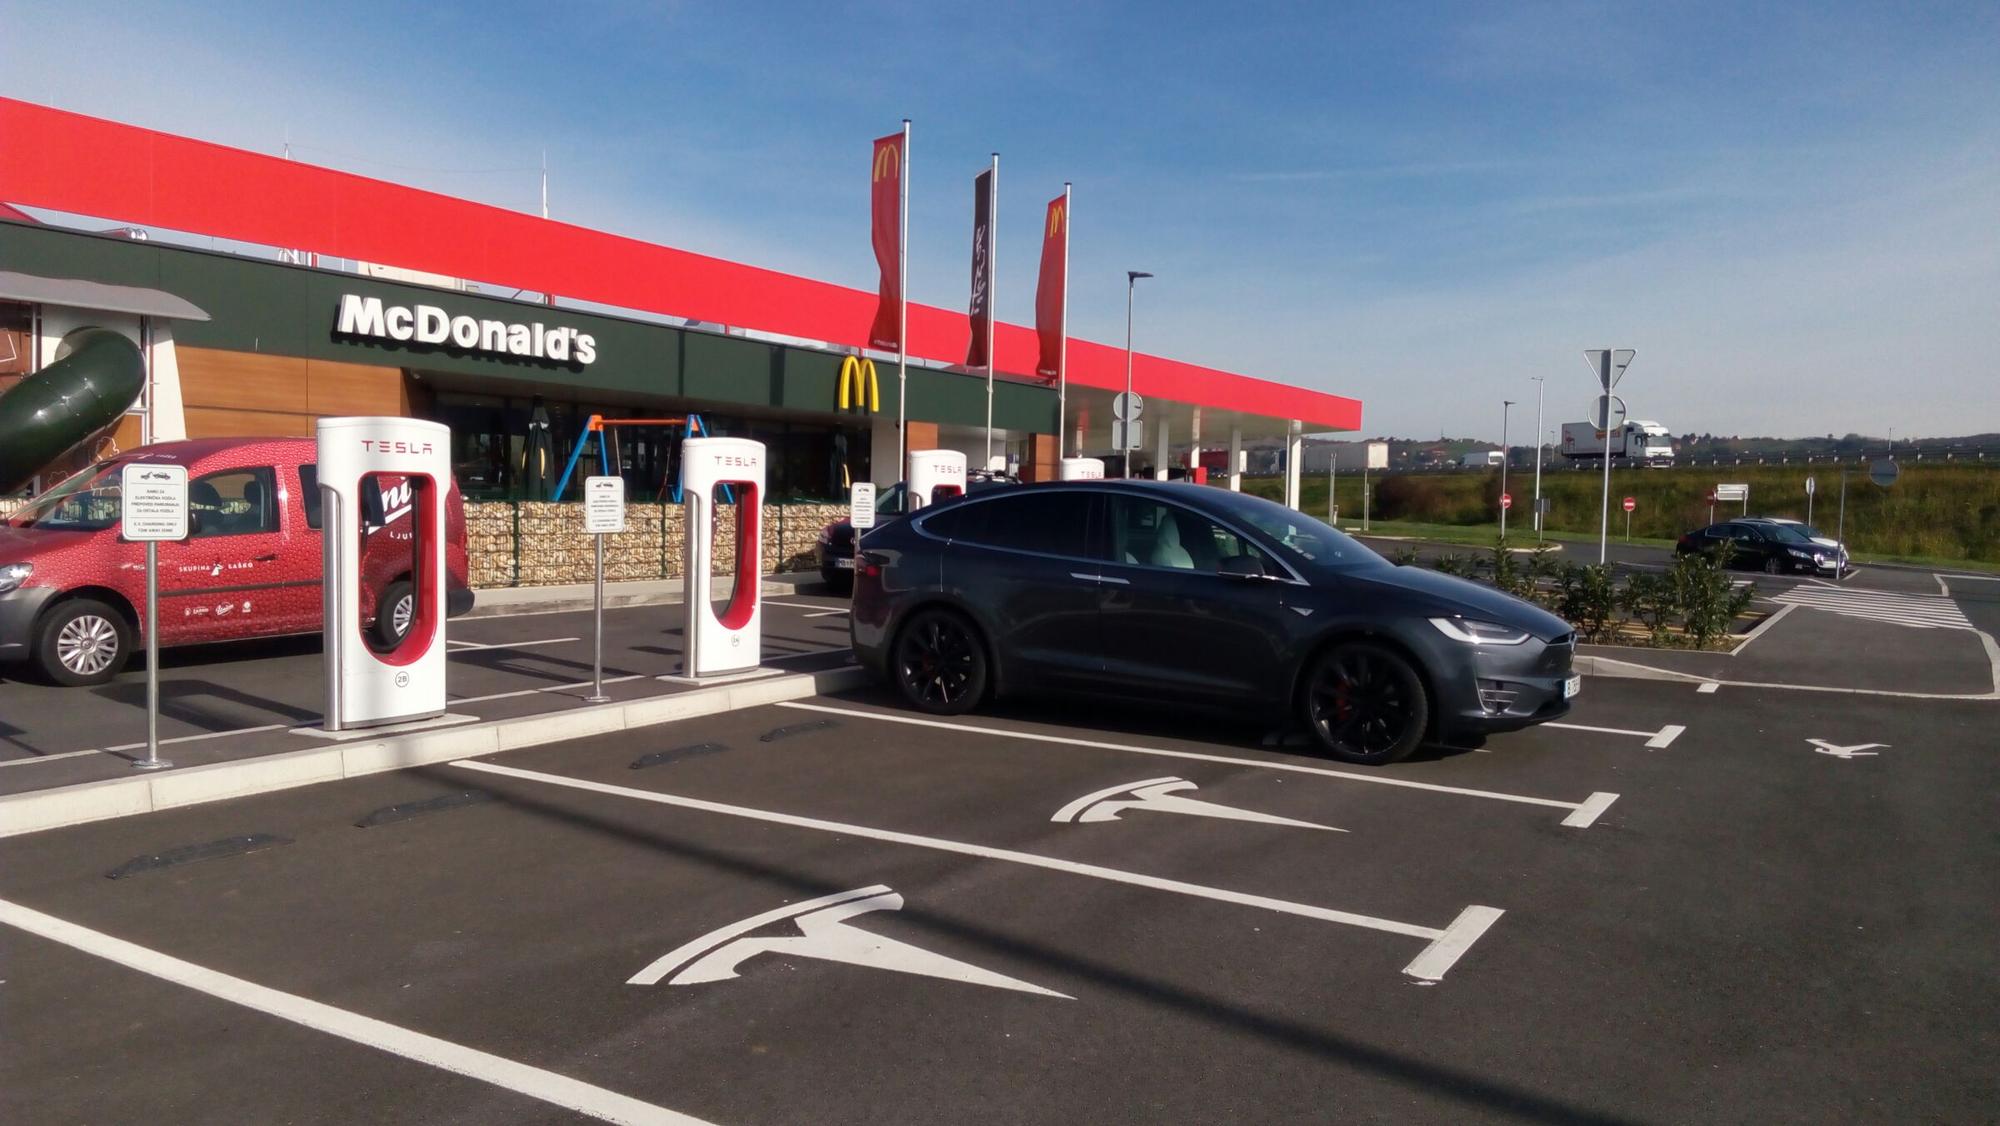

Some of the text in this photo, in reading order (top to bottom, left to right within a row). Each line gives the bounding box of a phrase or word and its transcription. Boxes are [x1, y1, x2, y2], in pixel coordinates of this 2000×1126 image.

[337, 293, 597, 365] McDonald's
[361, 440, 433, 455] TESLA
[714, 455, 757, 468] TESLA
[933, 464, 962, 474] TESLA
[178, 561, 254, 573] SKUPINA LAŠKO
[397, 675, 408, 683] 2B
